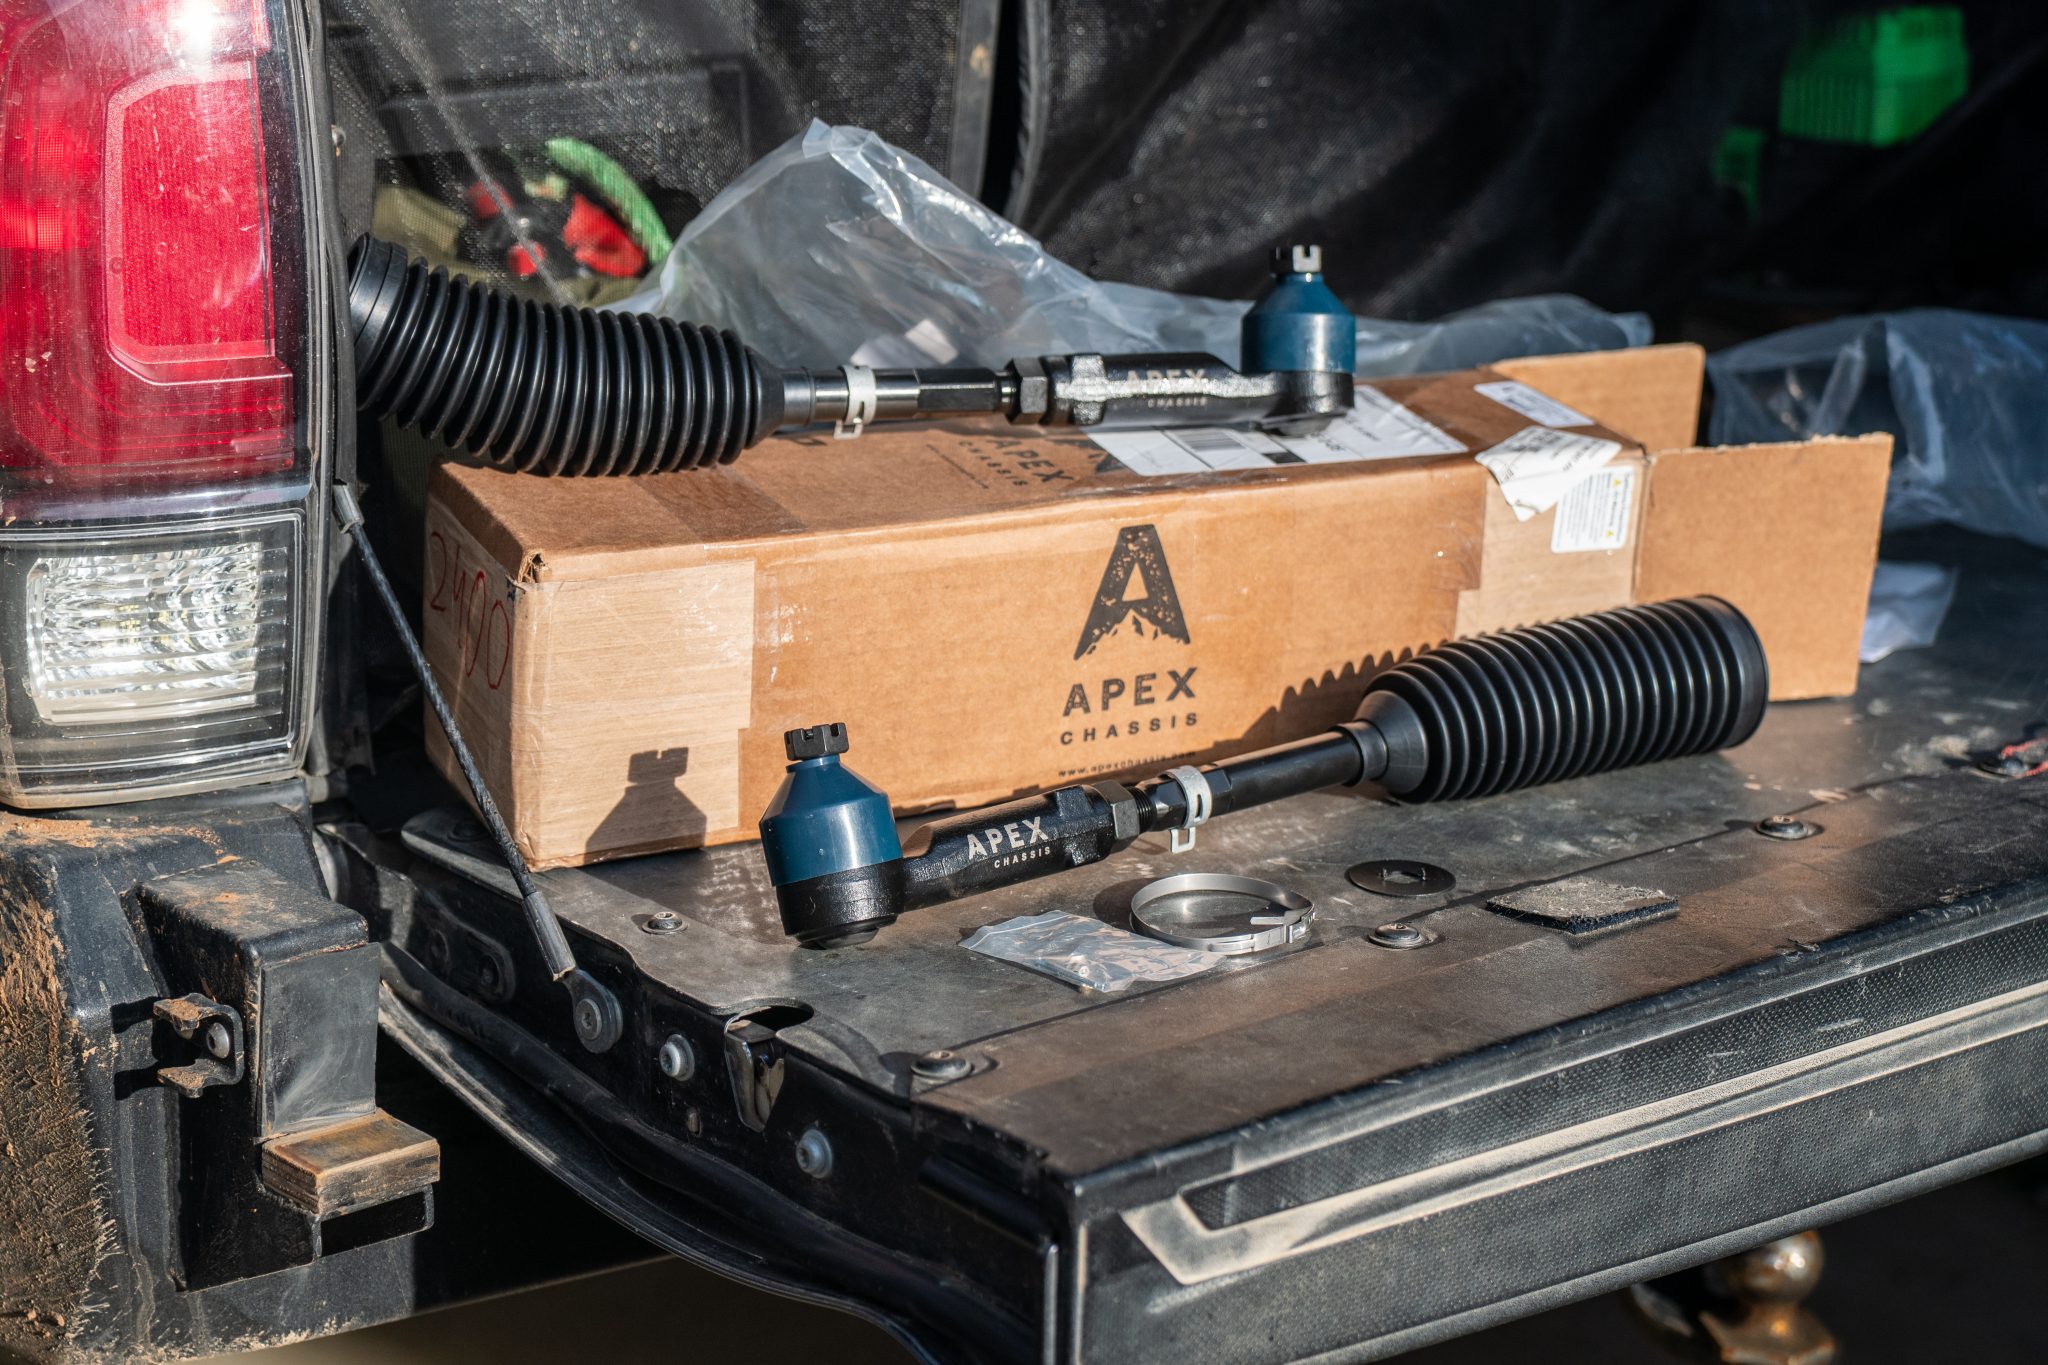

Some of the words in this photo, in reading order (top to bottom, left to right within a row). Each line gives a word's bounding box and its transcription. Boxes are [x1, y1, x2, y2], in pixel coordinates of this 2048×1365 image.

[986, 439, 1073, 483] APEX
[1062, 667, 1198, 717] APEX
[1060, 712, 1198, 745] CHASSIS
[966, 816, 1049, 860] APEX
[994, 846, 1051, 869] CHASSIS
